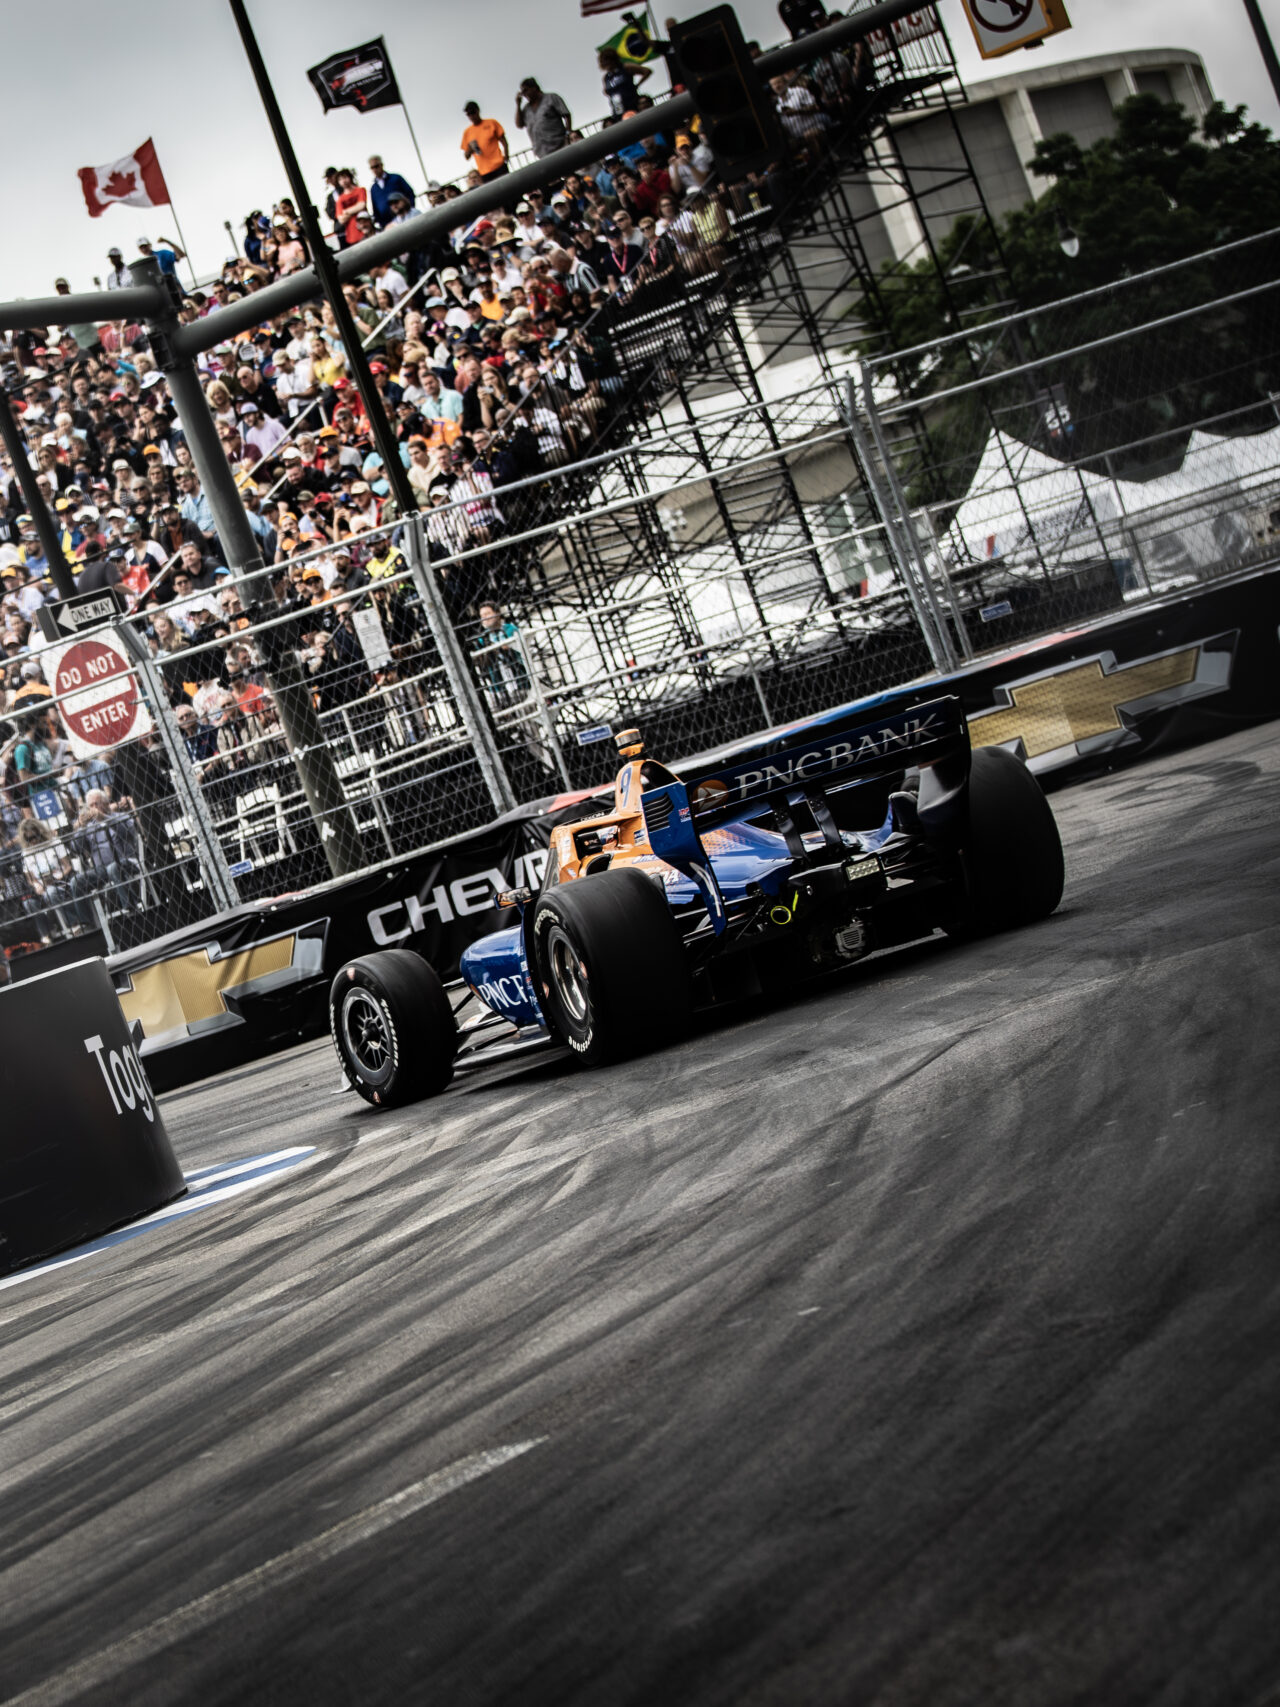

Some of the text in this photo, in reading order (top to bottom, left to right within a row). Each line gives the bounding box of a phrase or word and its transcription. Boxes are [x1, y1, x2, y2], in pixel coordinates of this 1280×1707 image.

[71, 600, 112, 623] ONE WAY
[59, 652, 116, 689] DO NOT
[81, 701, 129, 733] ENTER
[620, 767, 632, 807] 9
